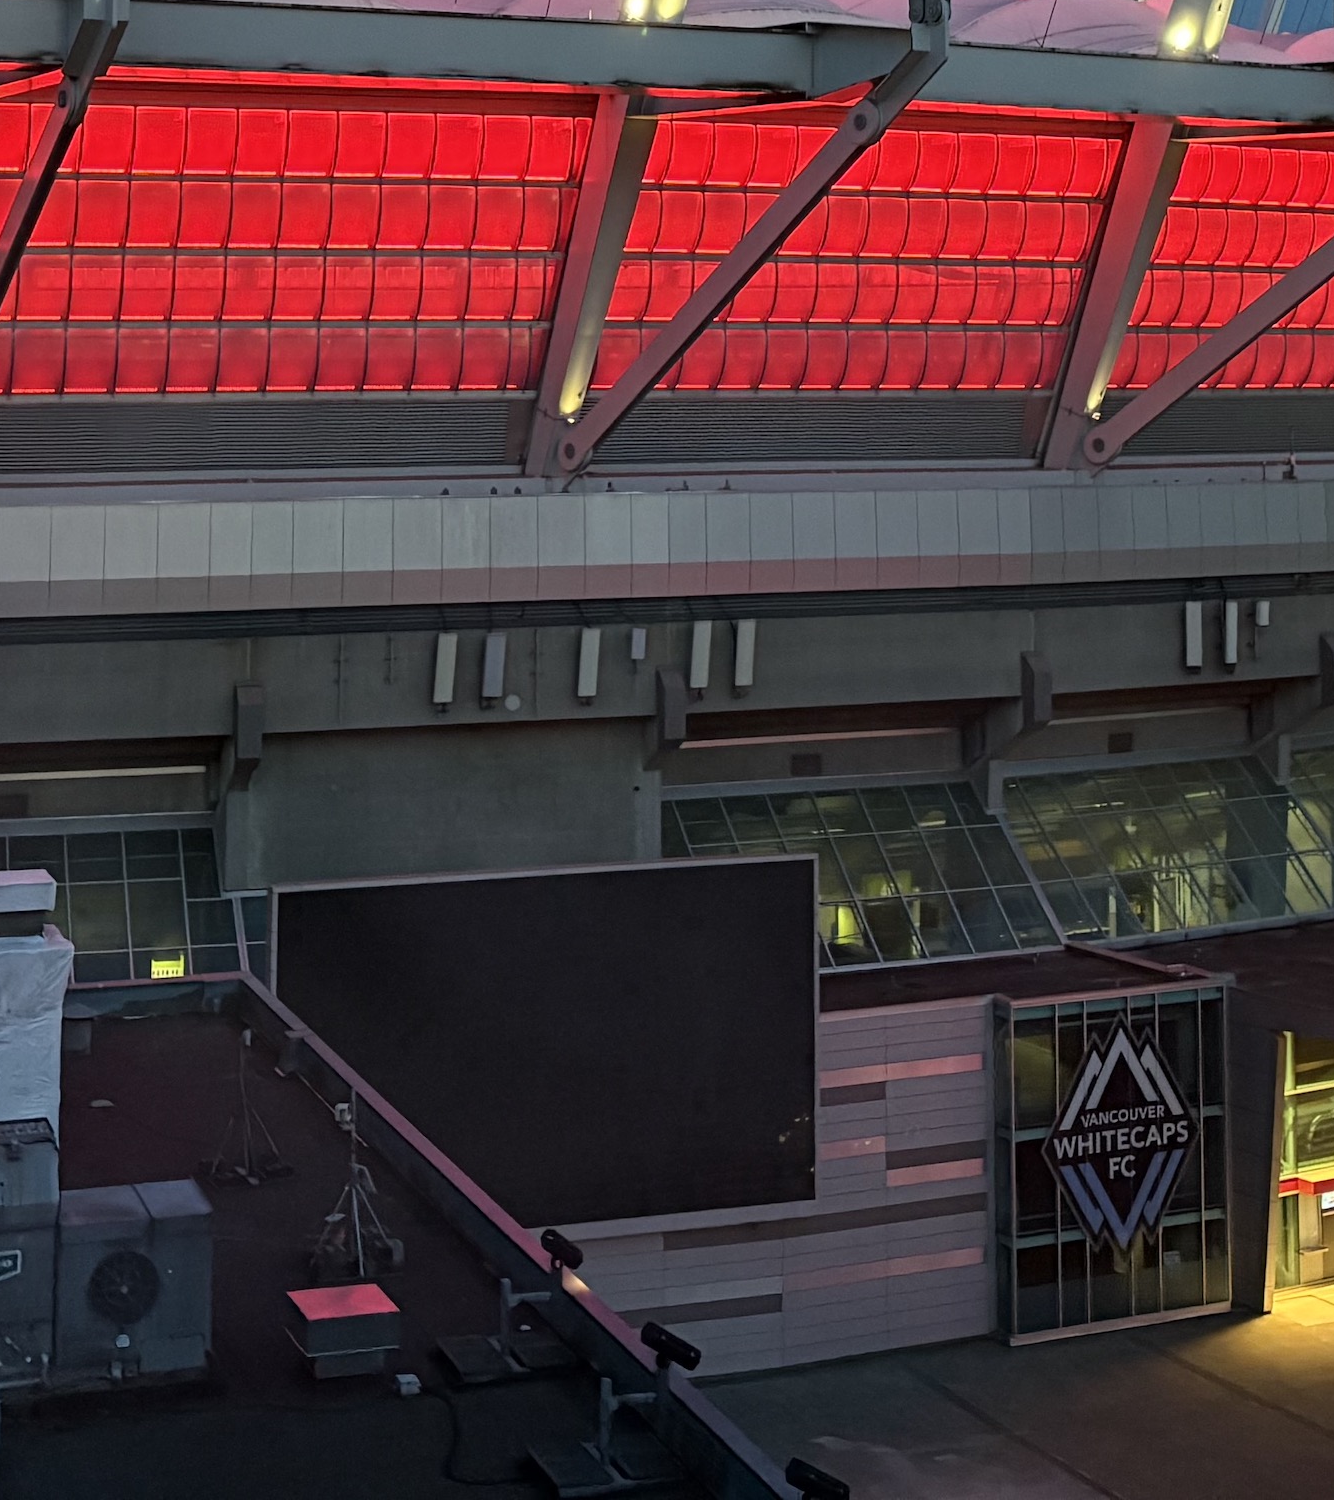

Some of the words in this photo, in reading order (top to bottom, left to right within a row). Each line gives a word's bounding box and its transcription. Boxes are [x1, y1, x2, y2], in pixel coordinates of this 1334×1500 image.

[1080, 1104, 1165, 1128] VANCOUVER
[1053, 1119, 1189, 1159] WHITECAPS
[1108, 1155, 1136, 1180] FC
